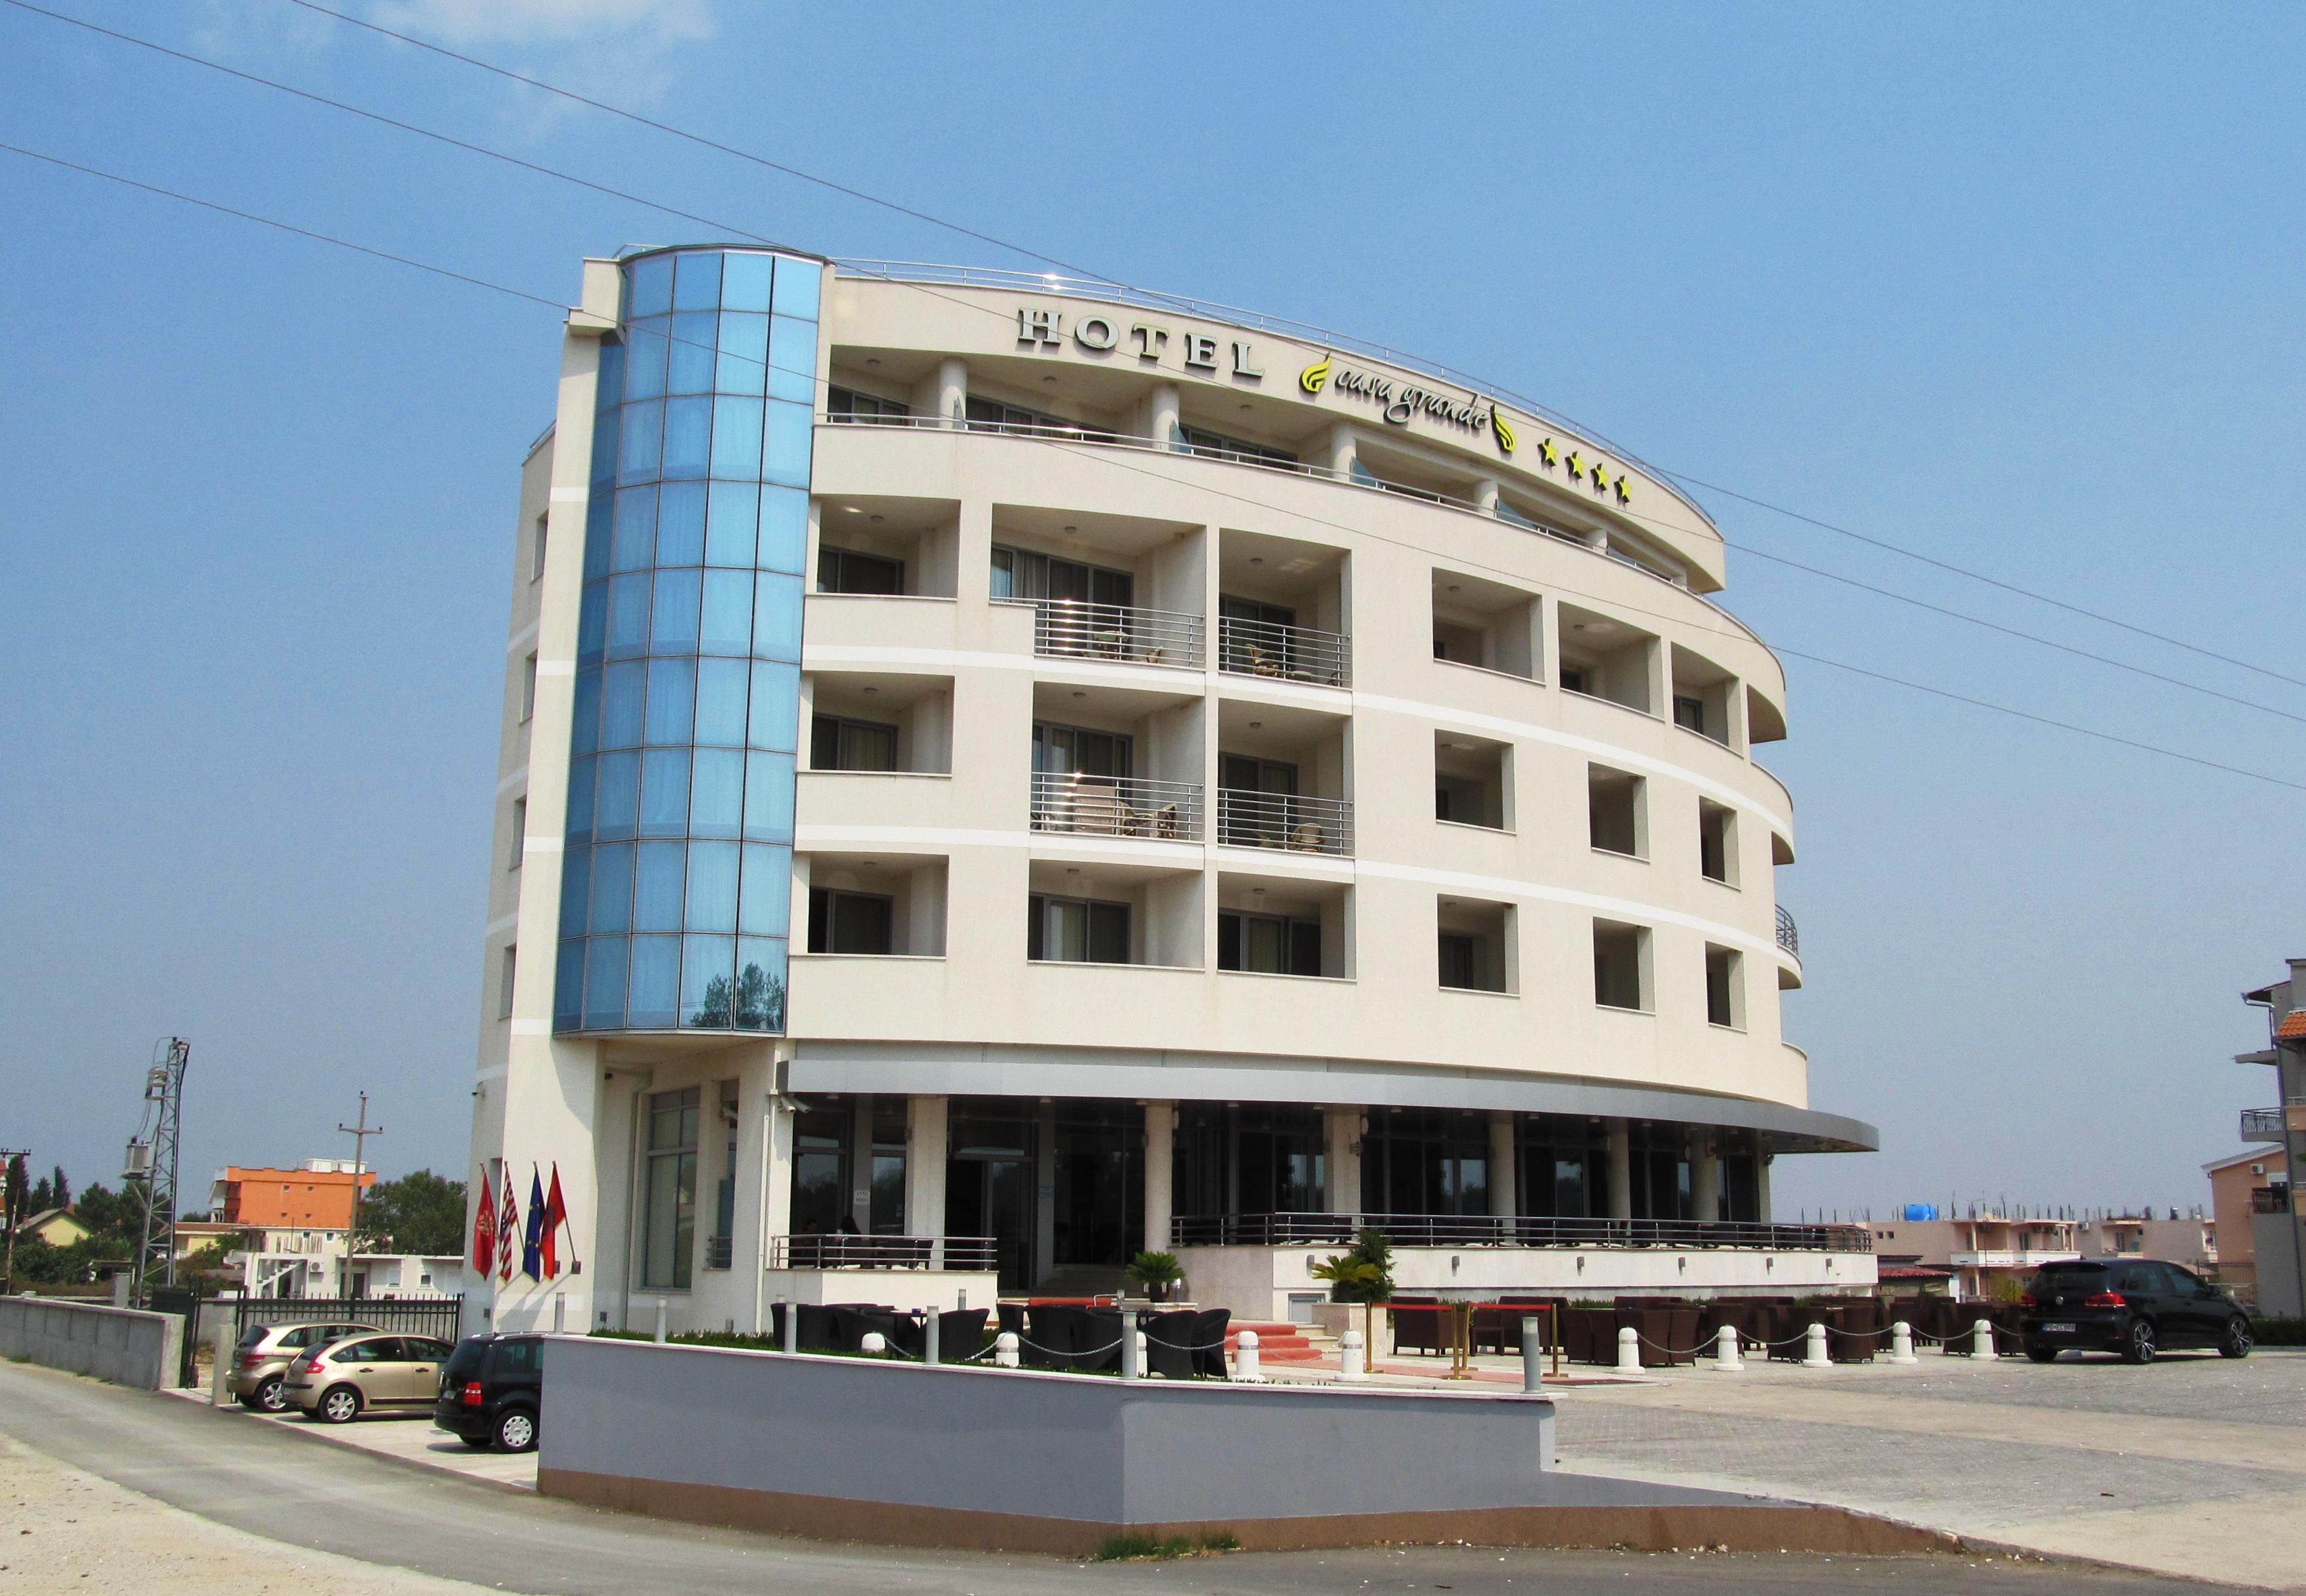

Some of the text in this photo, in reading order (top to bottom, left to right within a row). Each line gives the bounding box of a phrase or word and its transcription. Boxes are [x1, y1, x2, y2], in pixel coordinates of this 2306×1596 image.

[1017, 307, 1489, 429] HOTEL casa grande
